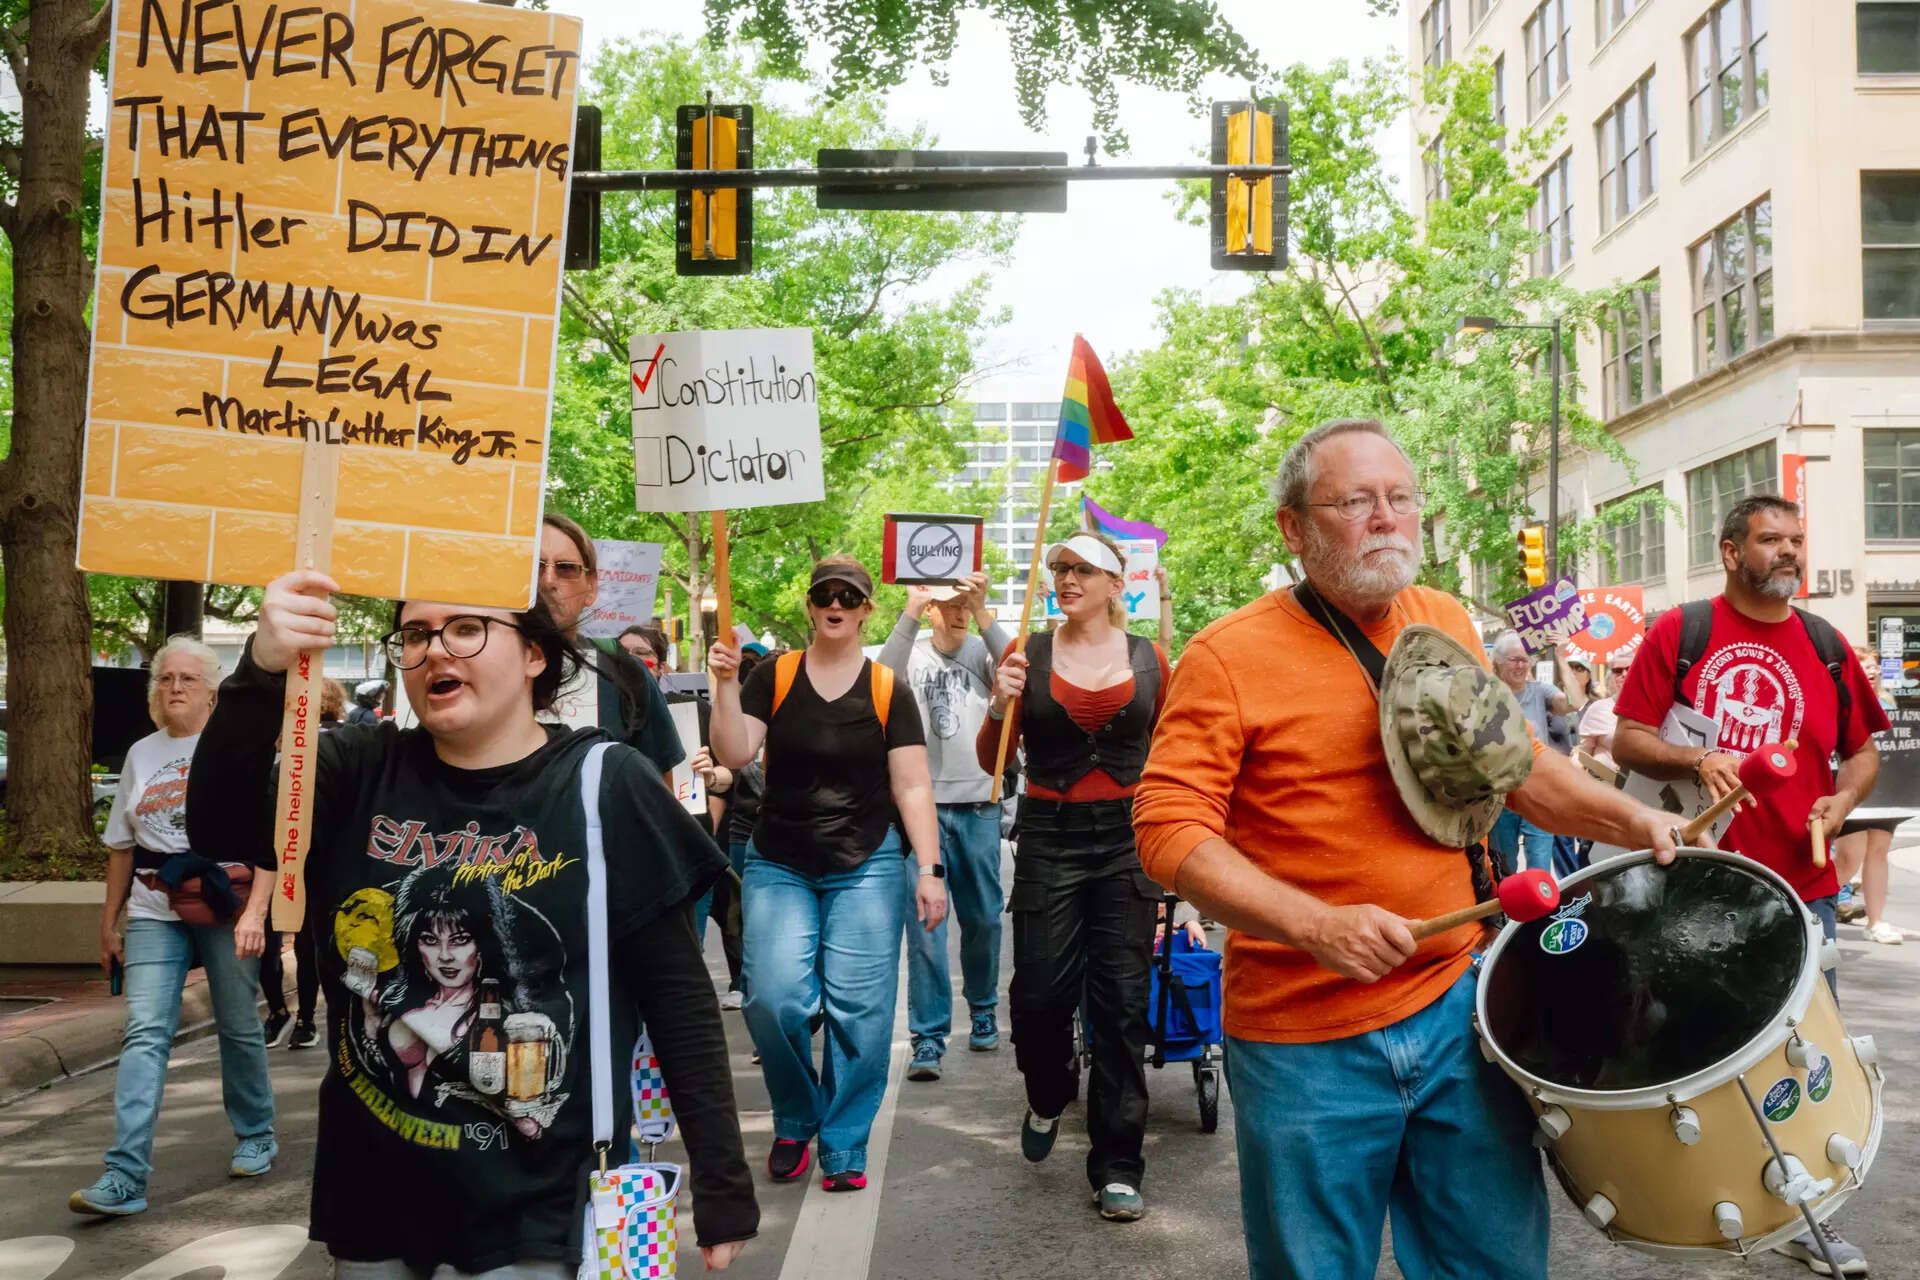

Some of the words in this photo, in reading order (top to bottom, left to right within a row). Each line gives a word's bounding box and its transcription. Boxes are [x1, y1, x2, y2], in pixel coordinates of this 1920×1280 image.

[137, 0, 356, 86] NEVER
[376, 16, 580, 106] FORGET
[114, 96, 265, 164] THAT
[279, 108, 568, 181] EVERYTHING
[133, 178, 307, 253] Hitler
[347, 199, 460, 257] DID
[462, 225, 553, 266] IN
[121, 264, 361, 347] GERMANY
[355, 308, 442, 350] was
[263, 345, 452, 403] LEGAL
[661, 355, 816, 407] Constitution
[325, 407, 416, 447] Luther
[418, 414, 480, 465] King
[666, 435, 806, 487] Dictator
[910, 544, 960, 557] BULLYING
[1817, 569, 1854, 596] 515
[1507, 595, 1561, 628] FUQ
[1517, 602, 1585, 650] TRUMP
[1604, 593, 1644, 625] EARTH
[1565, 641, 1597, 663] REAT
[1706, 652, 1734, 680] BEYOND
[1735, 648, 1765, 660] BOWS
[1774, 660, 1798, 700] ARROWS
[293, 689, 309, 749] place.
[287, 754, 304, 821] helpful
[283, 829, 299, 865] The
[514, 845, 534, 868] of
[502, 870, 523, 897] the
[525, 852, 581, 888] Dark
[350, 1072, 462, 1150] HALLOWEEN
